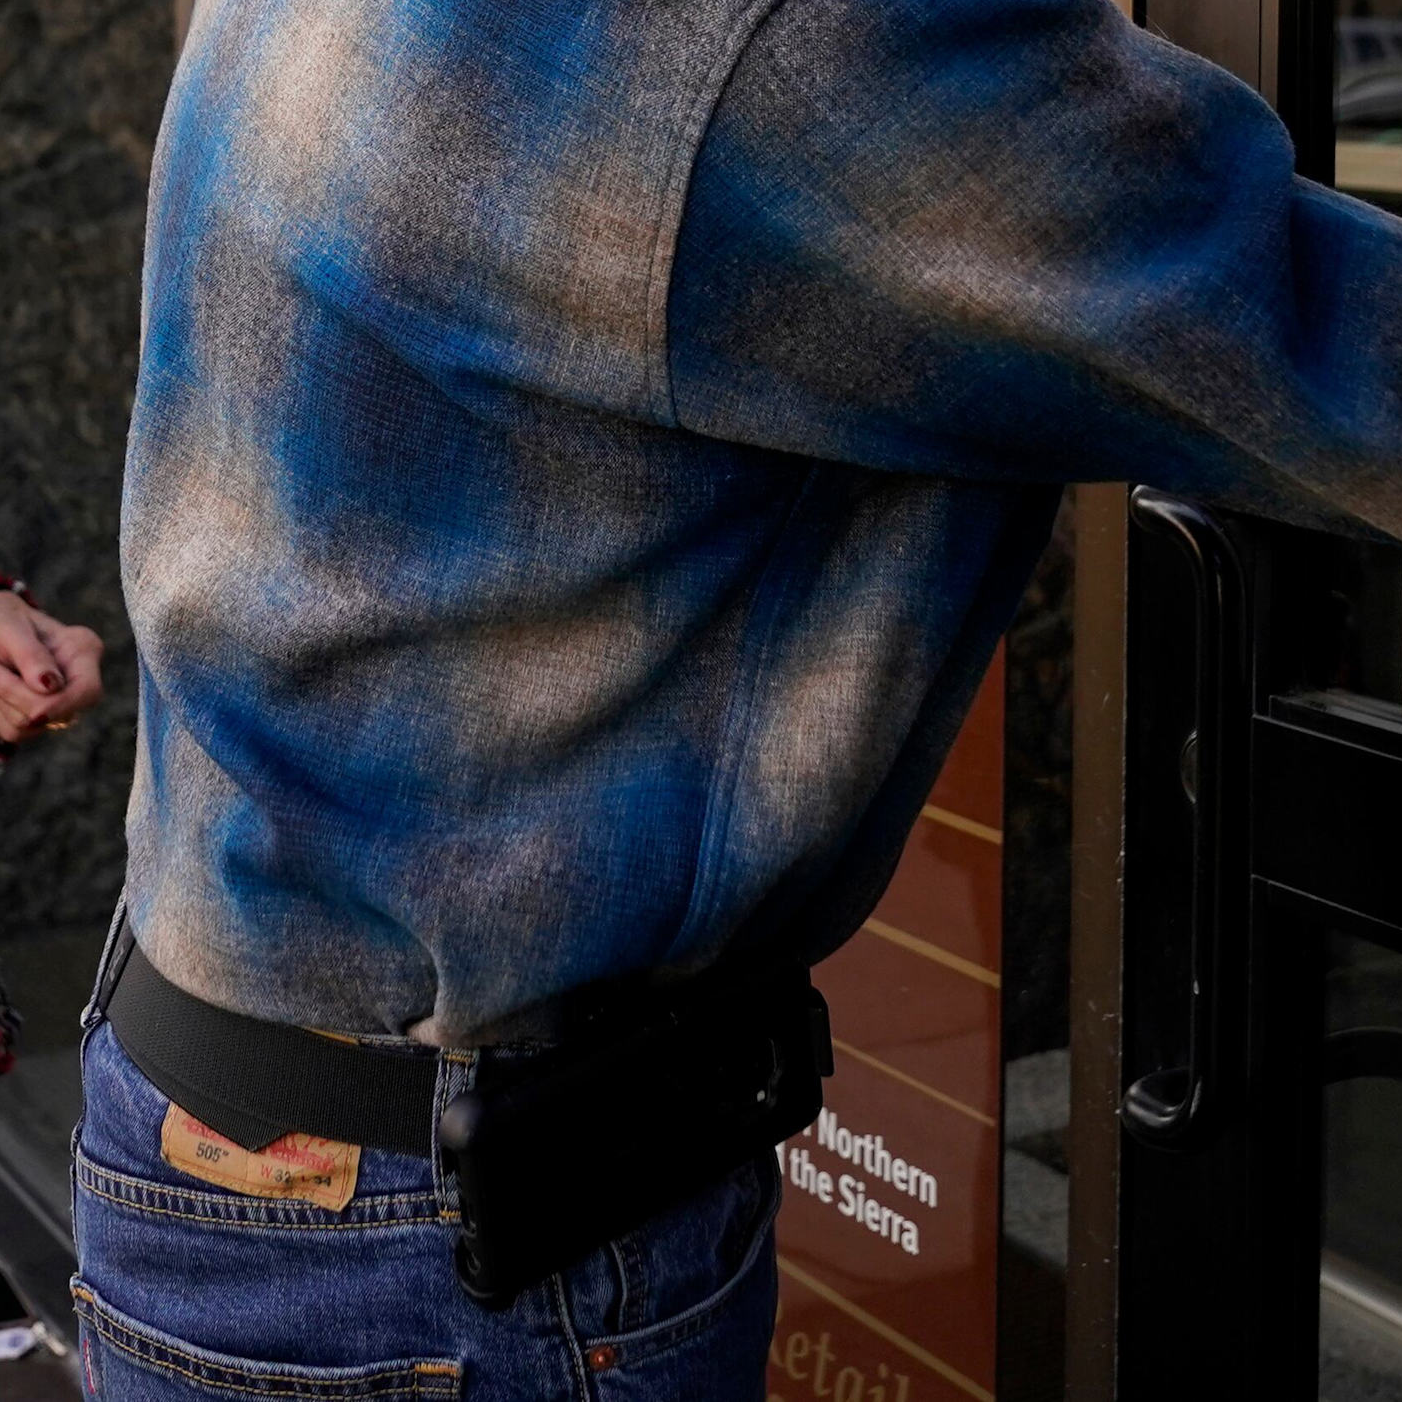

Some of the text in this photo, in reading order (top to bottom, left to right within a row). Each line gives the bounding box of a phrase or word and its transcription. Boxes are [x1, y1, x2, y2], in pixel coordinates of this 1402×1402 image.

[789, 1148, 834, 1204] the
[838, 1174, 920, 1256] Sierra
[817, 1106, 938, 1208] Northern
